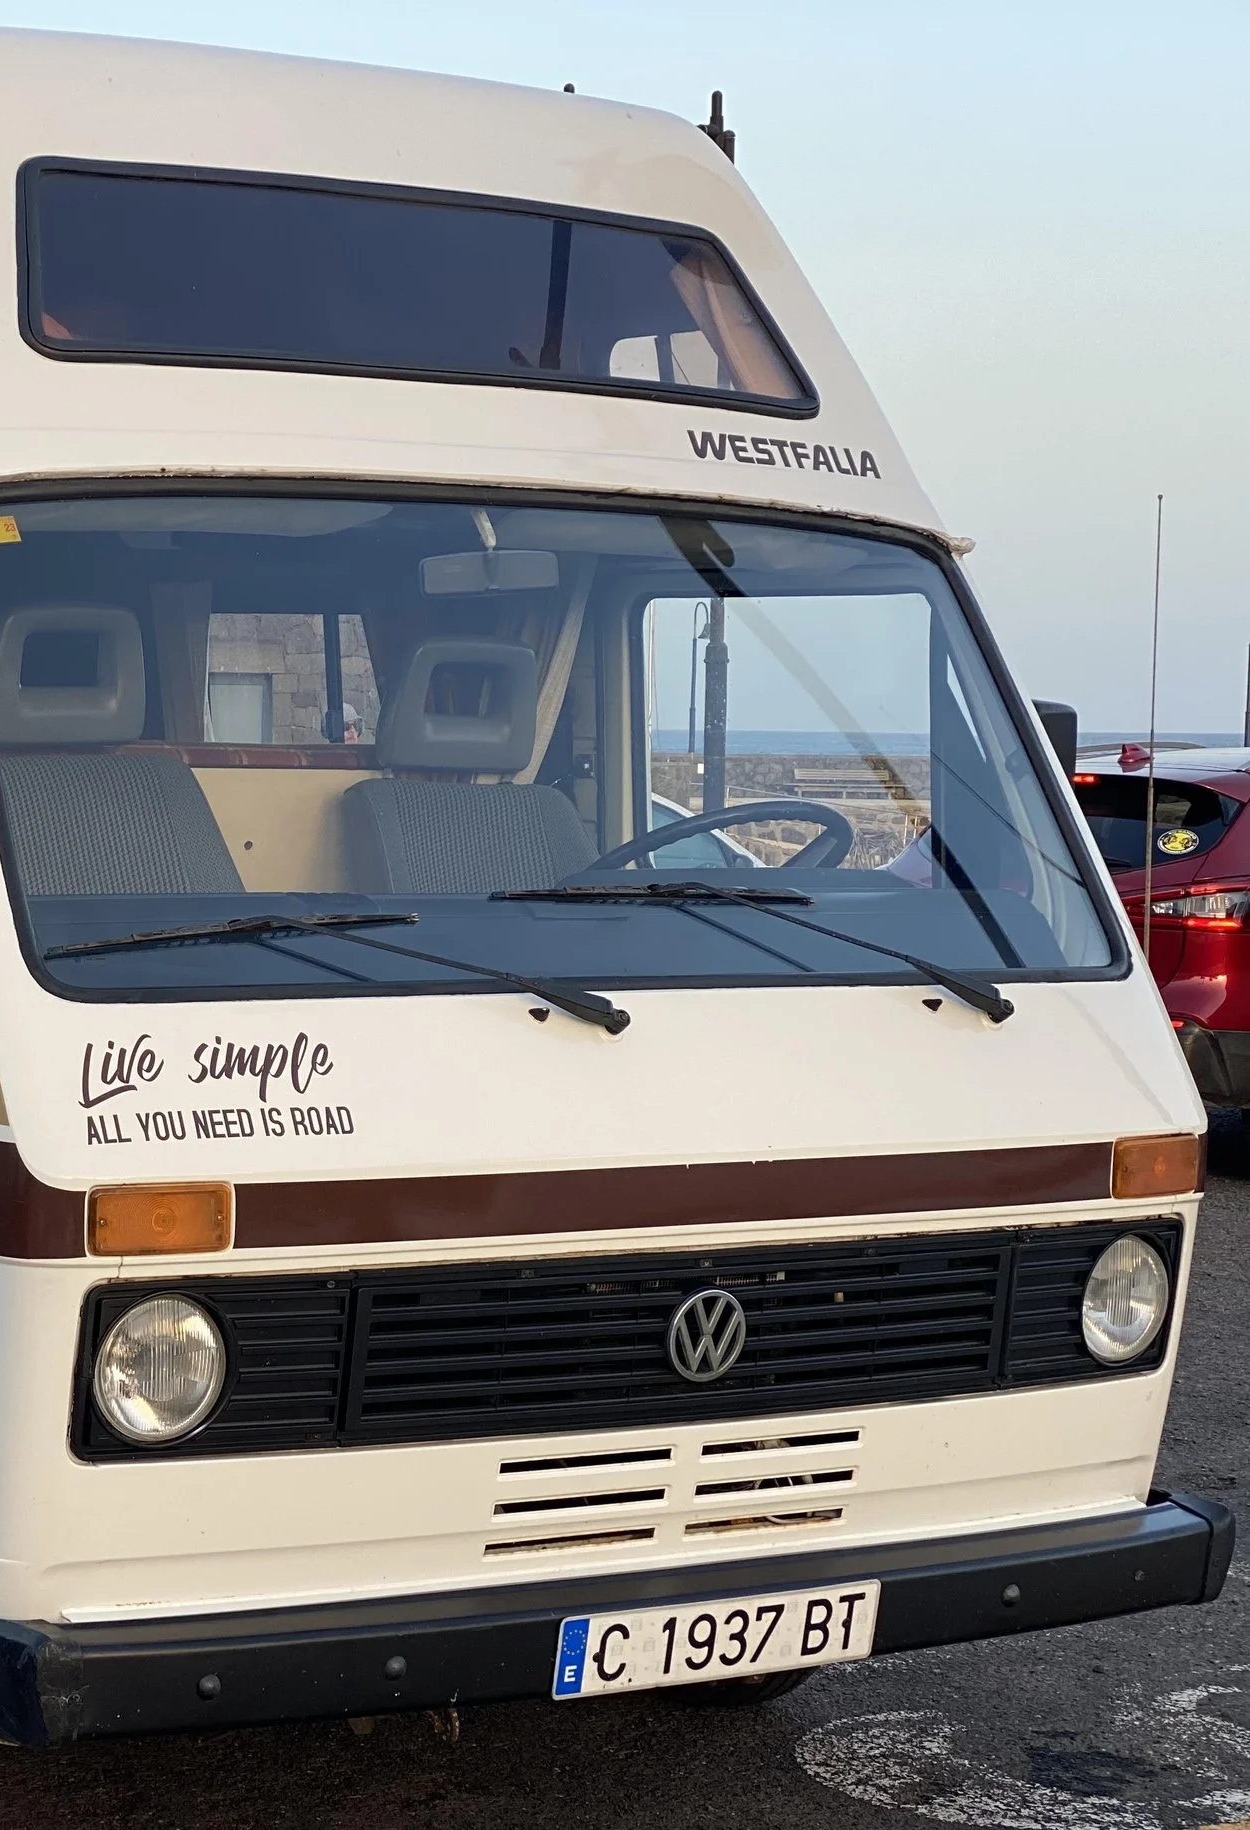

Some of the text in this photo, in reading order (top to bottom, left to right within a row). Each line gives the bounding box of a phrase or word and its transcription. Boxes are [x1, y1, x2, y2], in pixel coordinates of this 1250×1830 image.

[686, 429, 881, 479] WESTFALIA
[3, 523, 16, 532] 23
[78, 1031, 334, 1109] Live simple
[87, 1106, 355, 1145] ALL YOU NEED IS ROAD
[670, 1290, 746, 1382] VW
[596, 1592, 866, 1682] C 1937 BT
[563, 1664, 578, 1684] E
